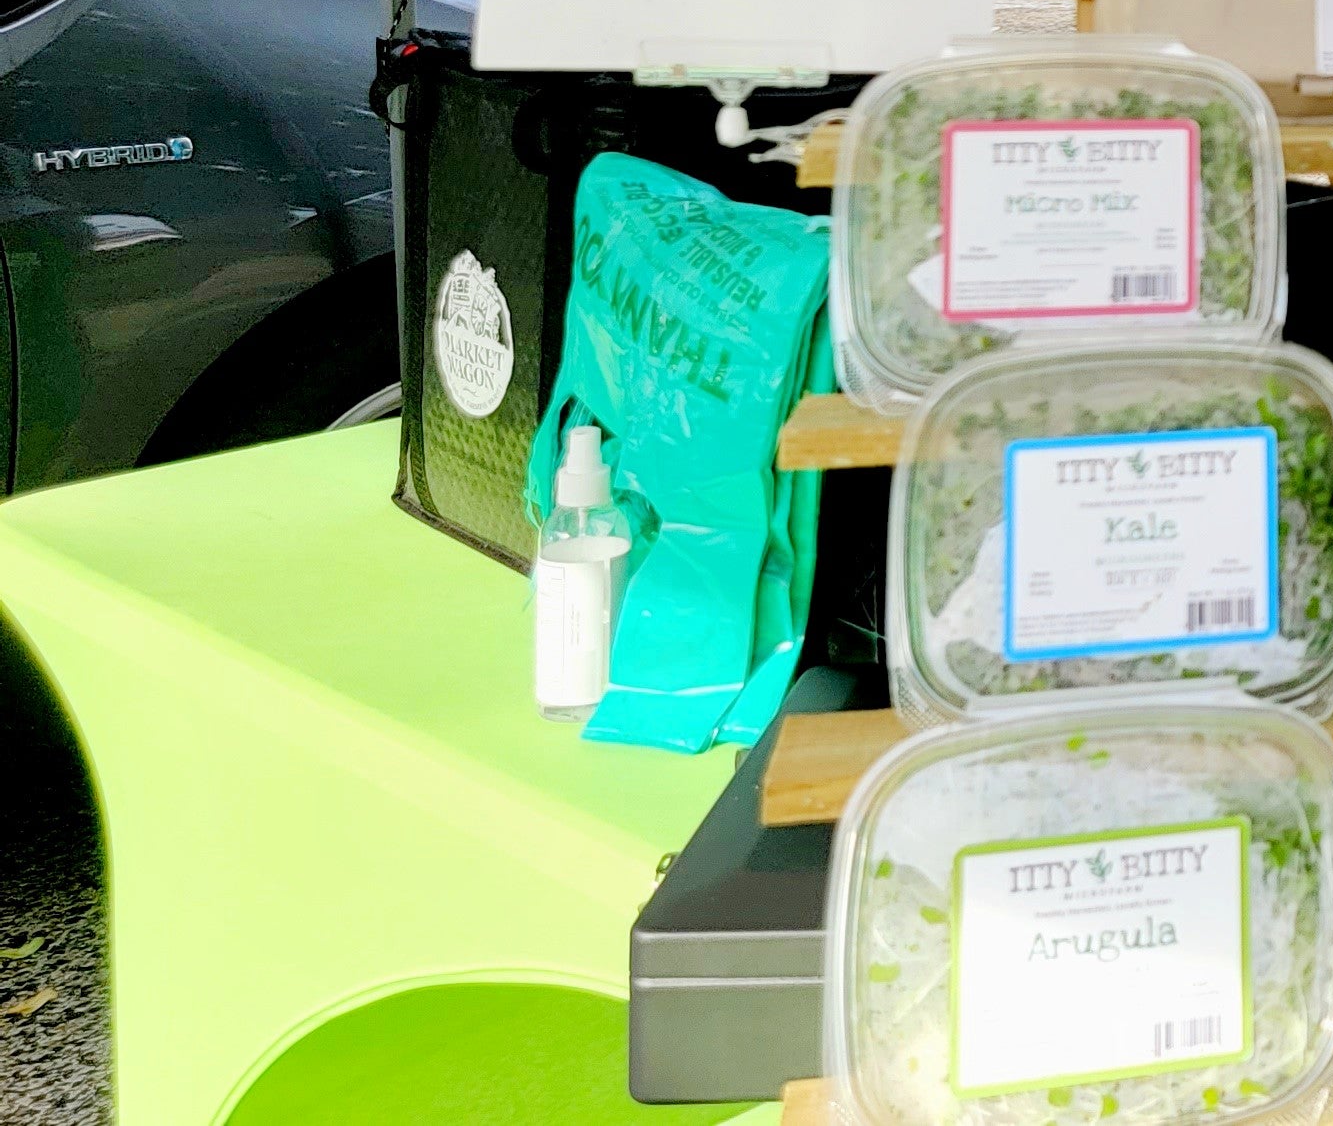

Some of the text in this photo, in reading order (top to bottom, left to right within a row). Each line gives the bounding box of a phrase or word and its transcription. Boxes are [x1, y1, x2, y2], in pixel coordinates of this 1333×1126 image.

[37, 143, 168, 172] HYBRID
[445, 331, 504, 371] MARKET
[447, 354, 495, 391] WAGON
[1103, 512, 1178, 544] Kale
[1008, 844, 1208, 893] ITTY BITTY
[1028, 916, 1179, 962] Arugula
